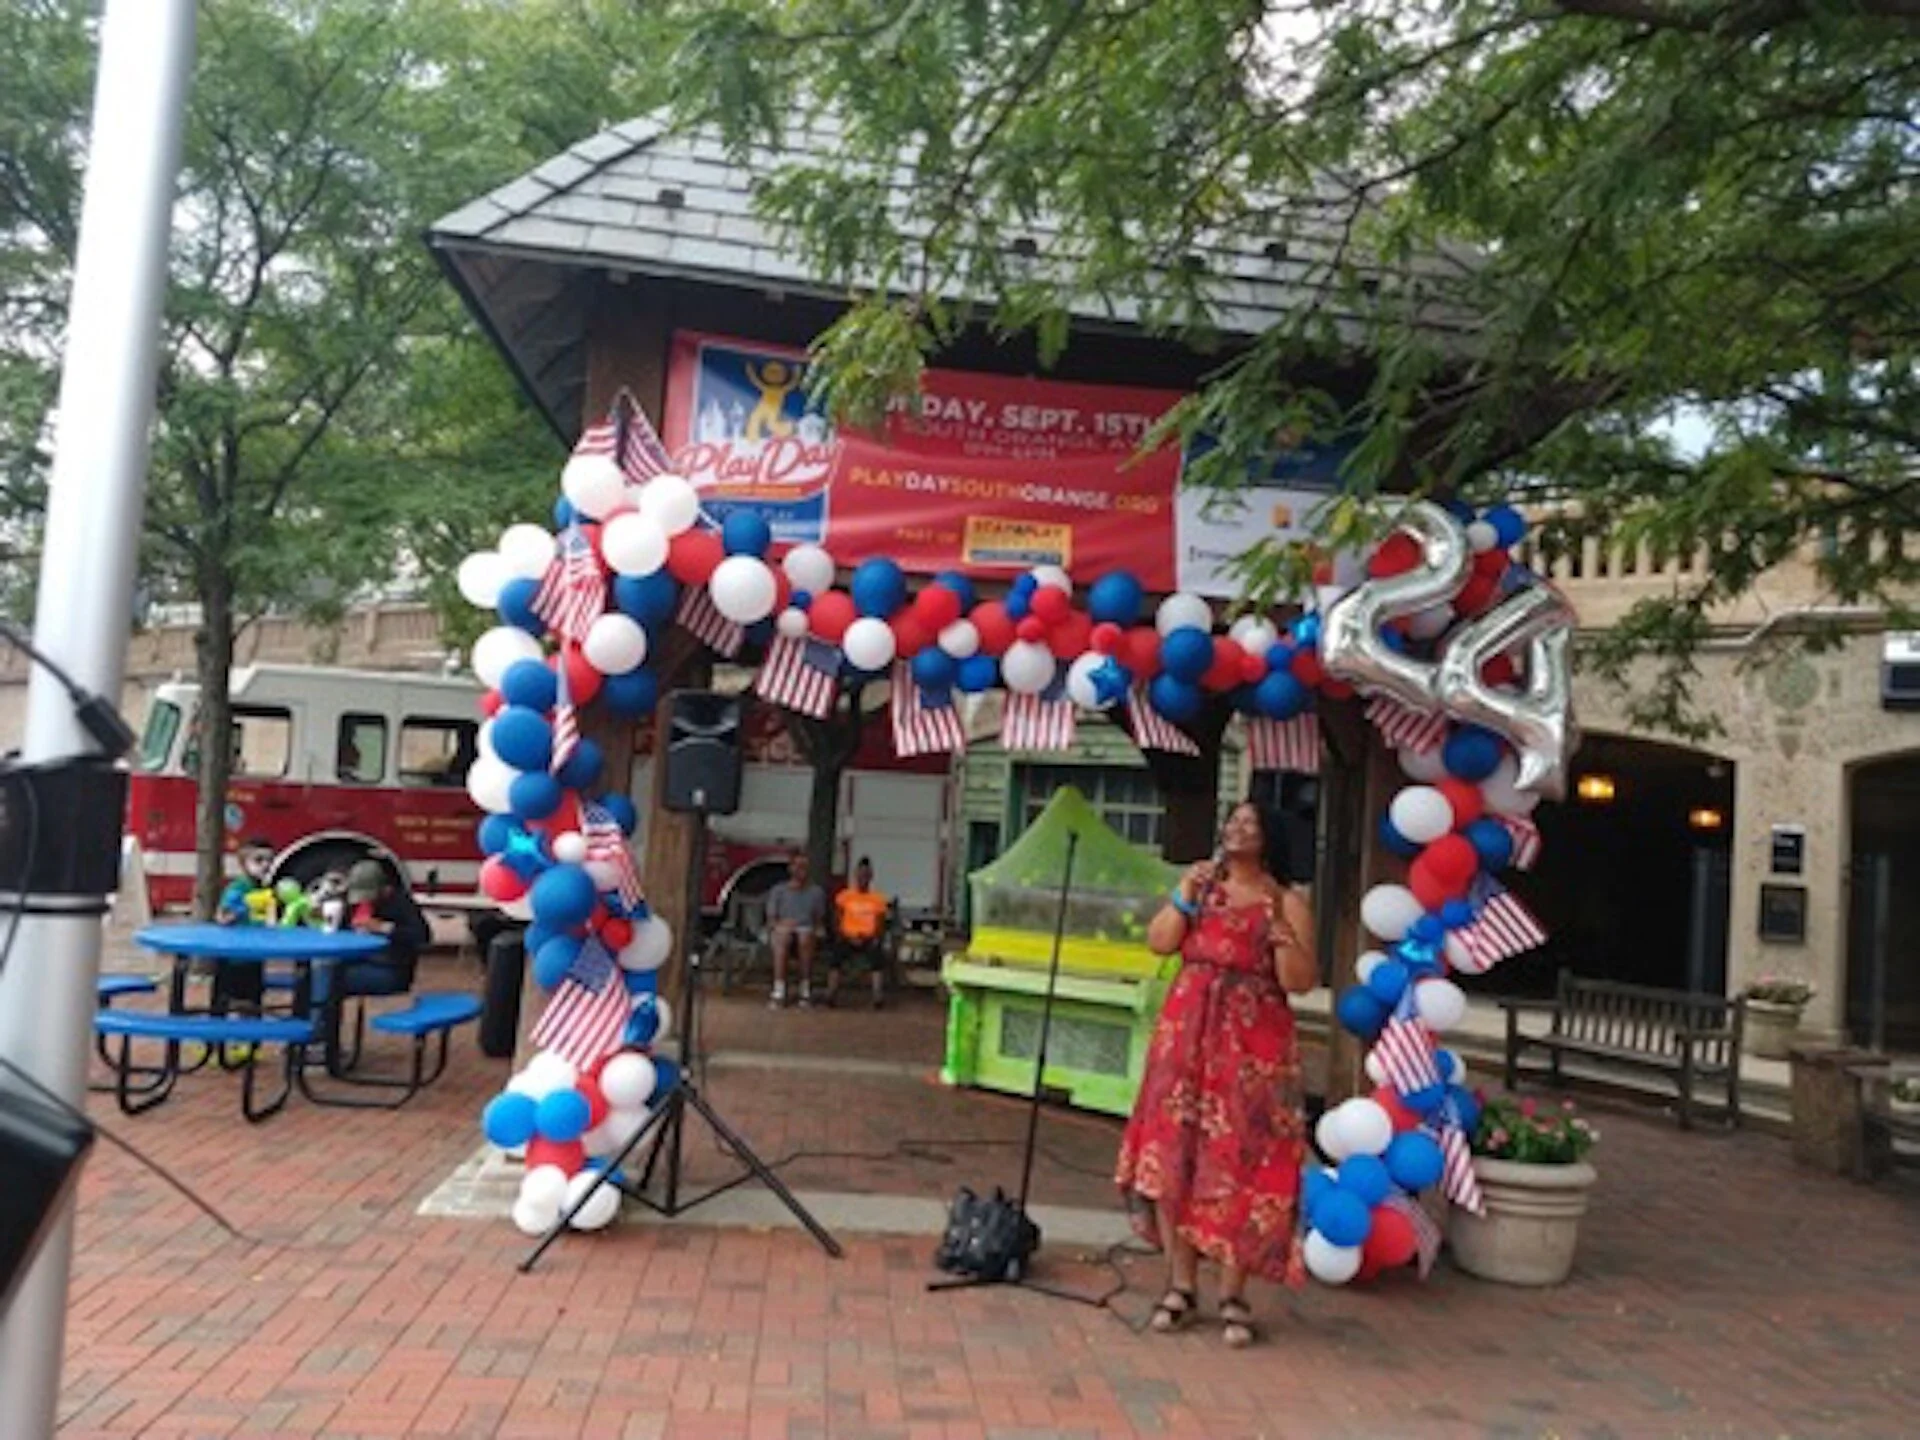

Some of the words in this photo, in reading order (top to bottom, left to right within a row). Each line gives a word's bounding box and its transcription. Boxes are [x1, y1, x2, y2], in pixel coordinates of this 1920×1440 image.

[1002, 404, 1085, 433] SEPT.
[675, 442, 764, 487] Play
[850, 465, 1159, 515] PLAYDAYSOUTHORANGE.ORG
